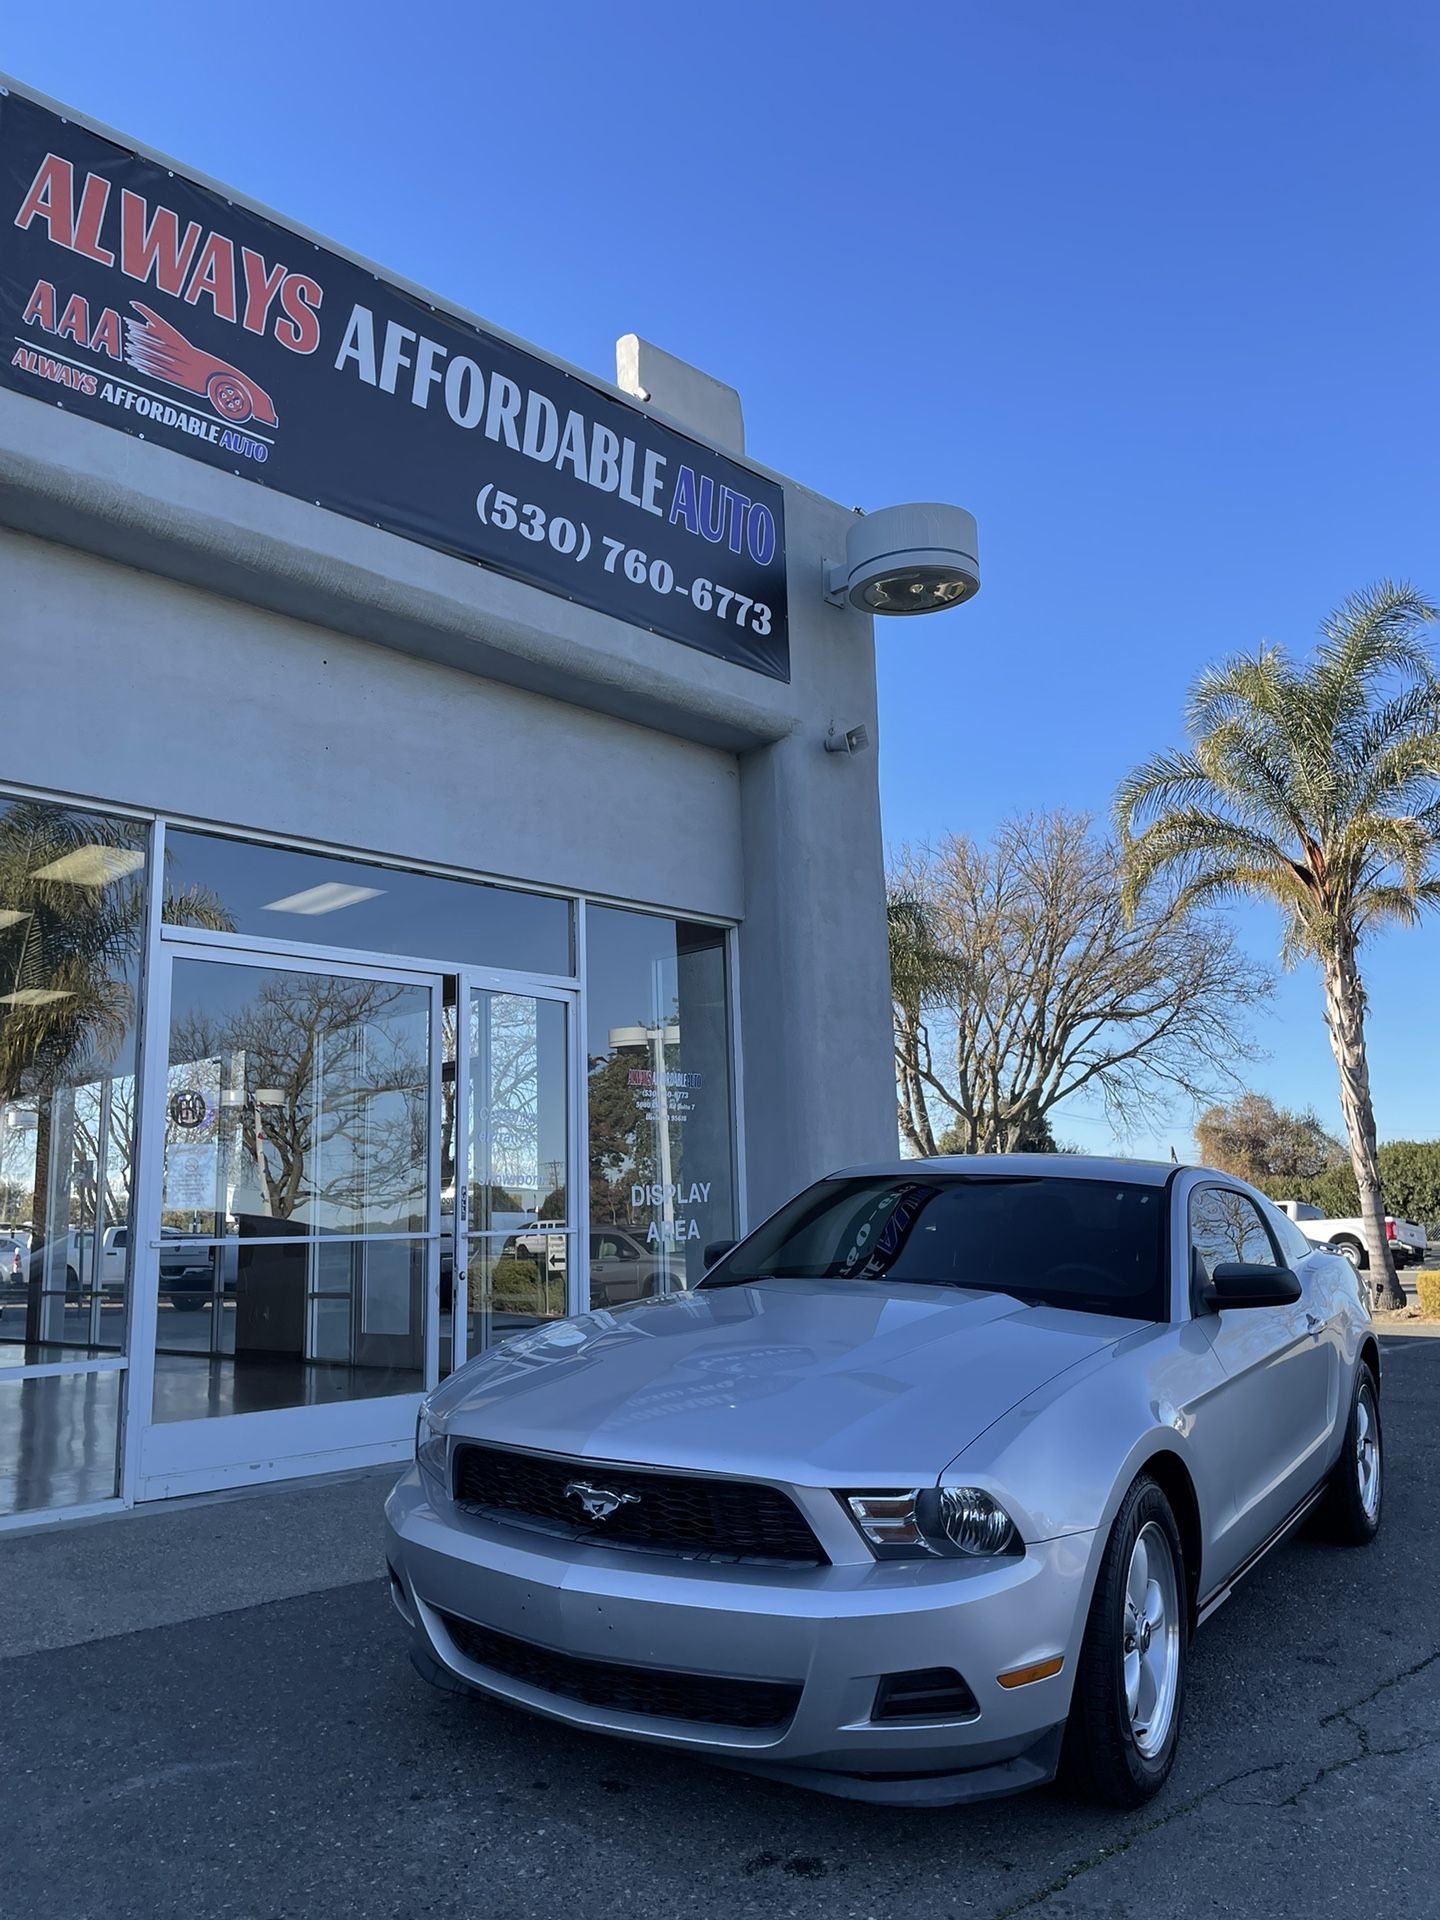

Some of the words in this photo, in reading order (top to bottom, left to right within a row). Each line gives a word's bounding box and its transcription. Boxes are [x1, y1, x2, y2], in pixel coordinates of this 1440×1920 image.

[14, 153, 324, 355] ALWAYS
[334, 303, 667, 518] AFFORDABLE
[669, 465, 777, 567] AUTO
[22, 280, 123, 362] AAA
[11, 348, 98, 396] ALWAYS
[100, 383, 220, 444] AFFORDABLE
[219, 431, 269, 463] AUTO
[476, 483, 592, 562] (530)
[601, 537, 773, 636] 760-6773
[631, 1182, 712, 1208] DISPLAY
[646, 1218, 701, 1243] AREA
